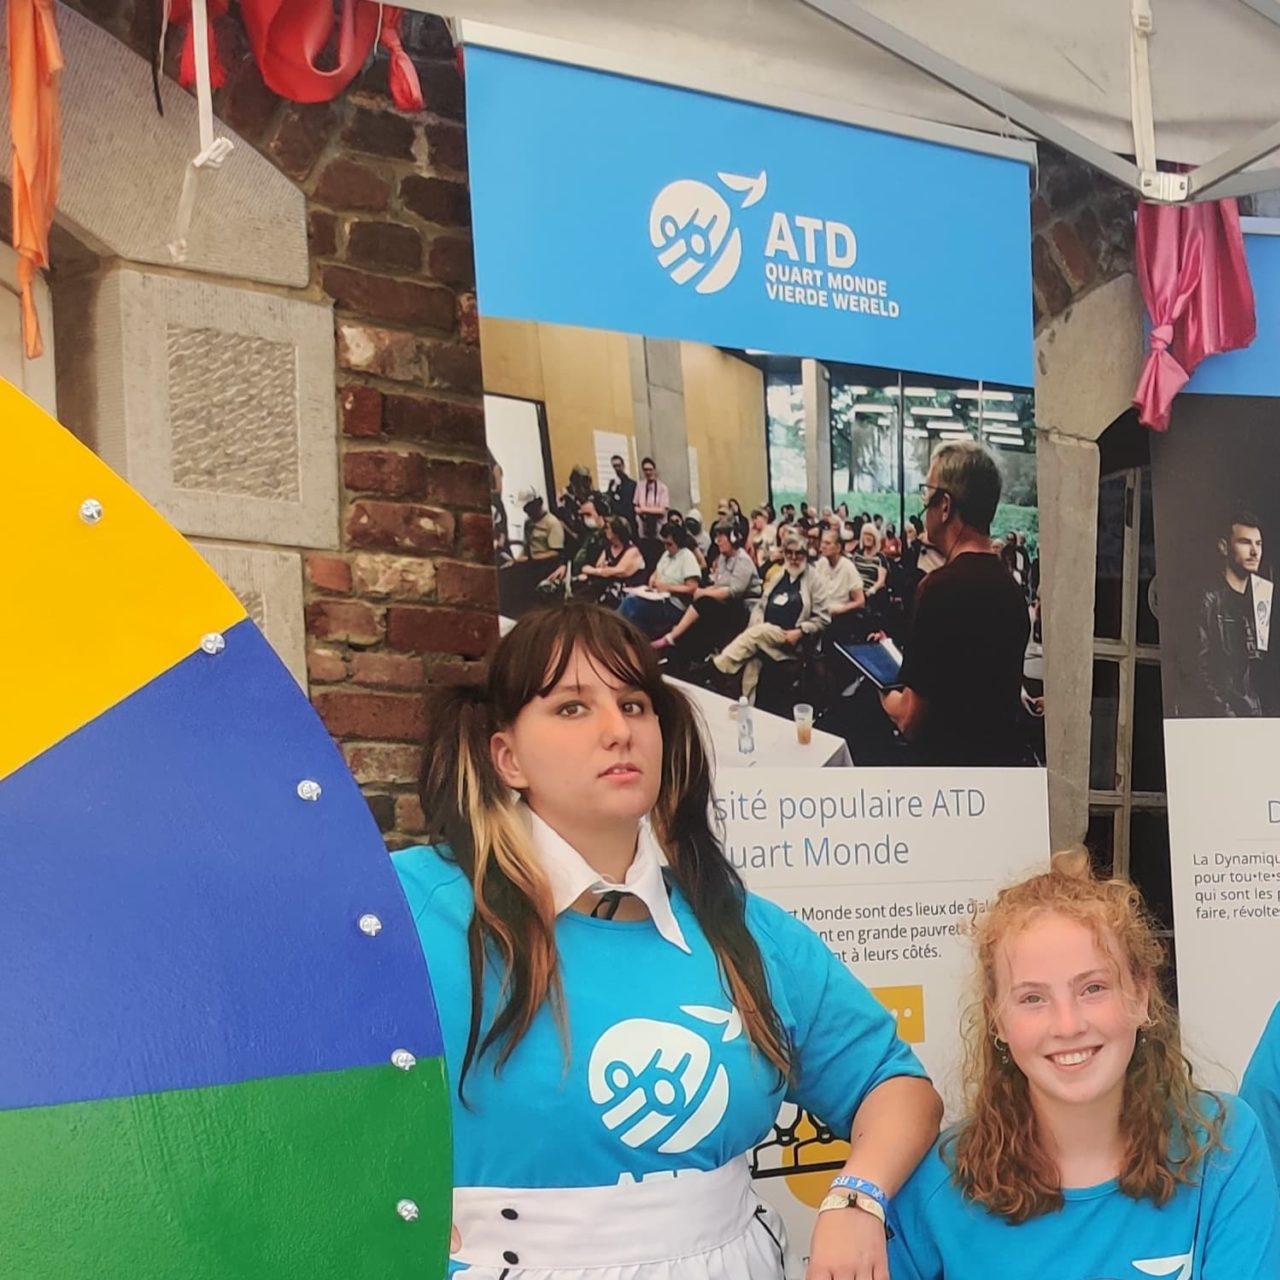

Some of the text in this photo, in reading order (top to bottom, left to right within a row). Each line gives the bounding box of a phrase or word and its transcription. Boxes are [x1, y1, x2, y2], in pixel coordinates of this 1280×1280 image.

[764, 212, 857, 269] ATD
[765, 263, 887, 297] QUART MONDE
[766, 282, 899, 318] VIERDE WERELD
[714, 788, 986, 828] sité populaire ATD
[729, 835, 910, 868] uart Monde
[1193, 853, 1208, 866] La
[1194, 873, 1226, 886] pour
[1195, 889, 1217, 904] qui
[1220, 889, 1250, 901] sont
[1254, 888, 1273, 900] les
[802, 905, 852, 922] Monde
[855, 906, 886, 919] sont
[889, 903, 913, 918] des
[915, 902, 946, 916] lieux
[948, 900, 964, 914] de
[1196, 905, 1230, 920] faire,
[837, 929, 855, 942] en
[858, 924, 907, 944] grande
[851, 948, 860, 962] à
[864, 946, 899, 961] leurs
[903, 943, 942, 960] côtés.
